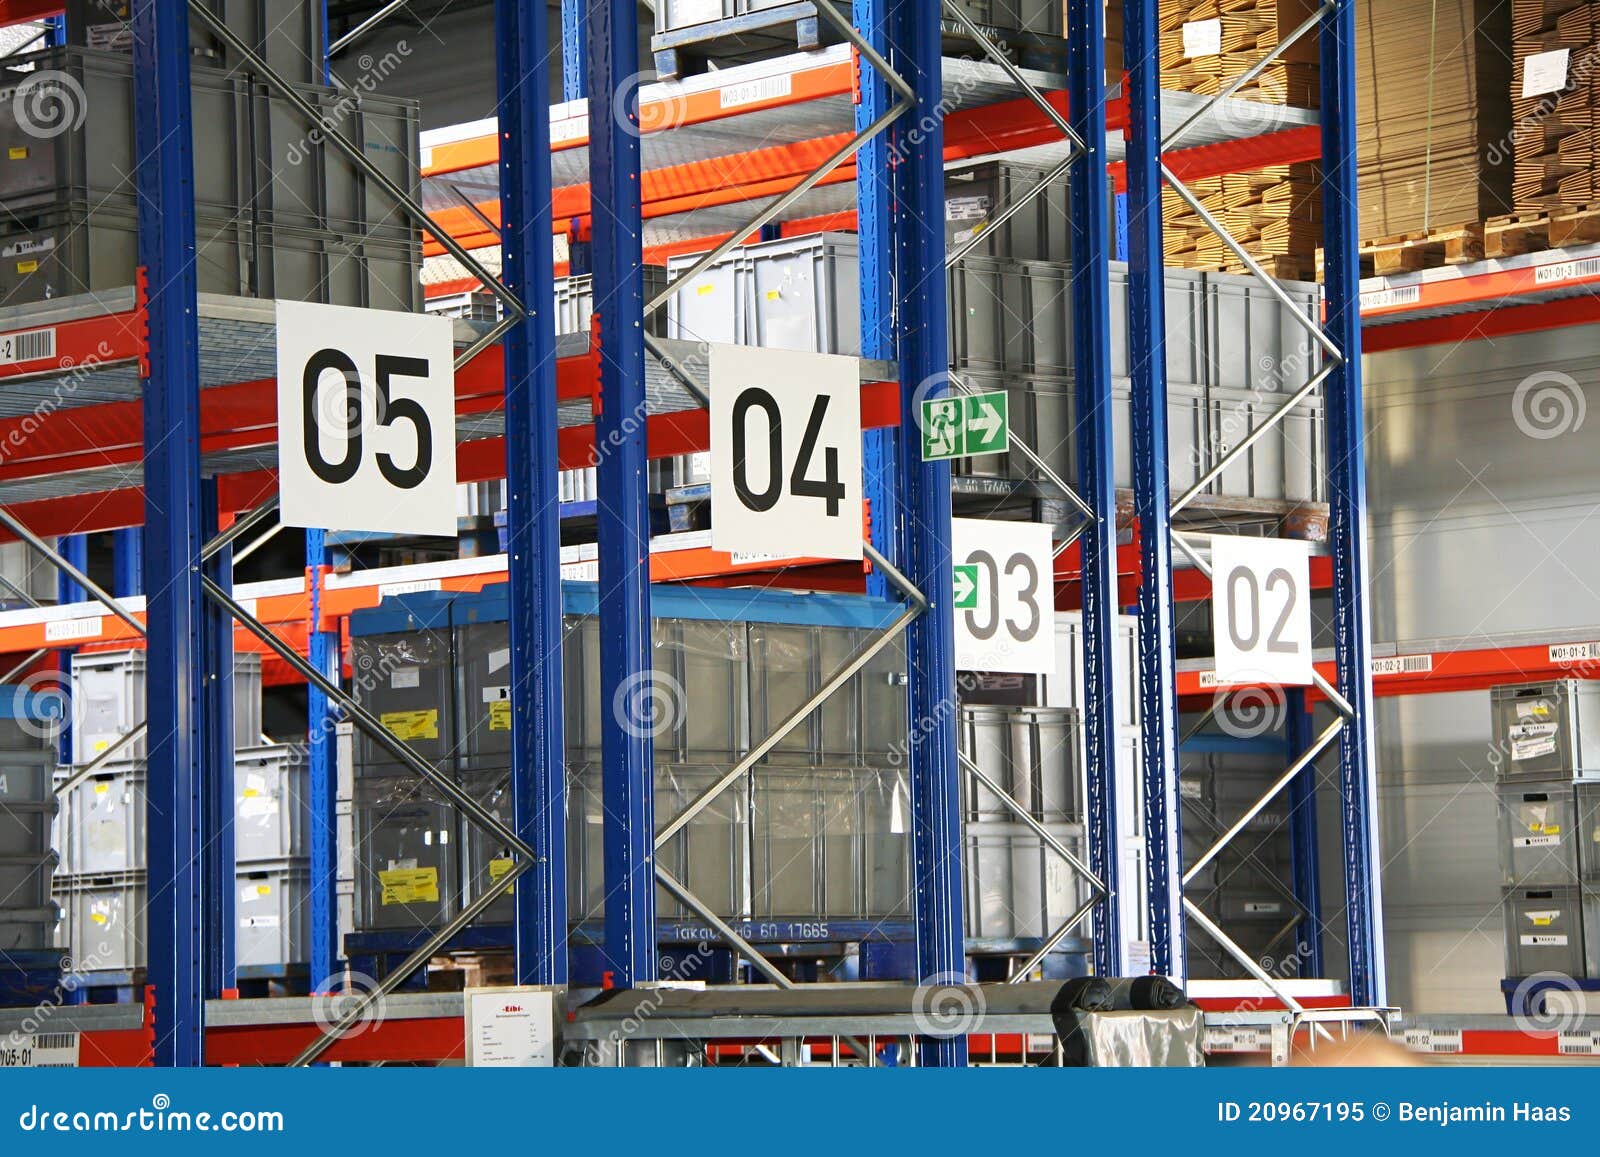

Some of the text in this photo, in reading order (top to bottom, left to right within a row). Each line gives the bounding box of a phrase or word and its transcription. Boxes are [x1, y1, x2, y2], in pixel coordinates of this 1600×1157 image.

[1537, 264, 1573, 281] W01-01-3
[1359, 292, 1389, 307] 01-02-3
[302, 348, 433, 490] 05
[731, 386, 846, 517] 04
[964, 549, 1041, 643] 03
[1226, 565, 1299, 654] 02
[1551, 646, 1586, 659] W01-01-2
[787, 922, 829, 939] 17665
[1406, 1035, 1430, 1045] W01-02
